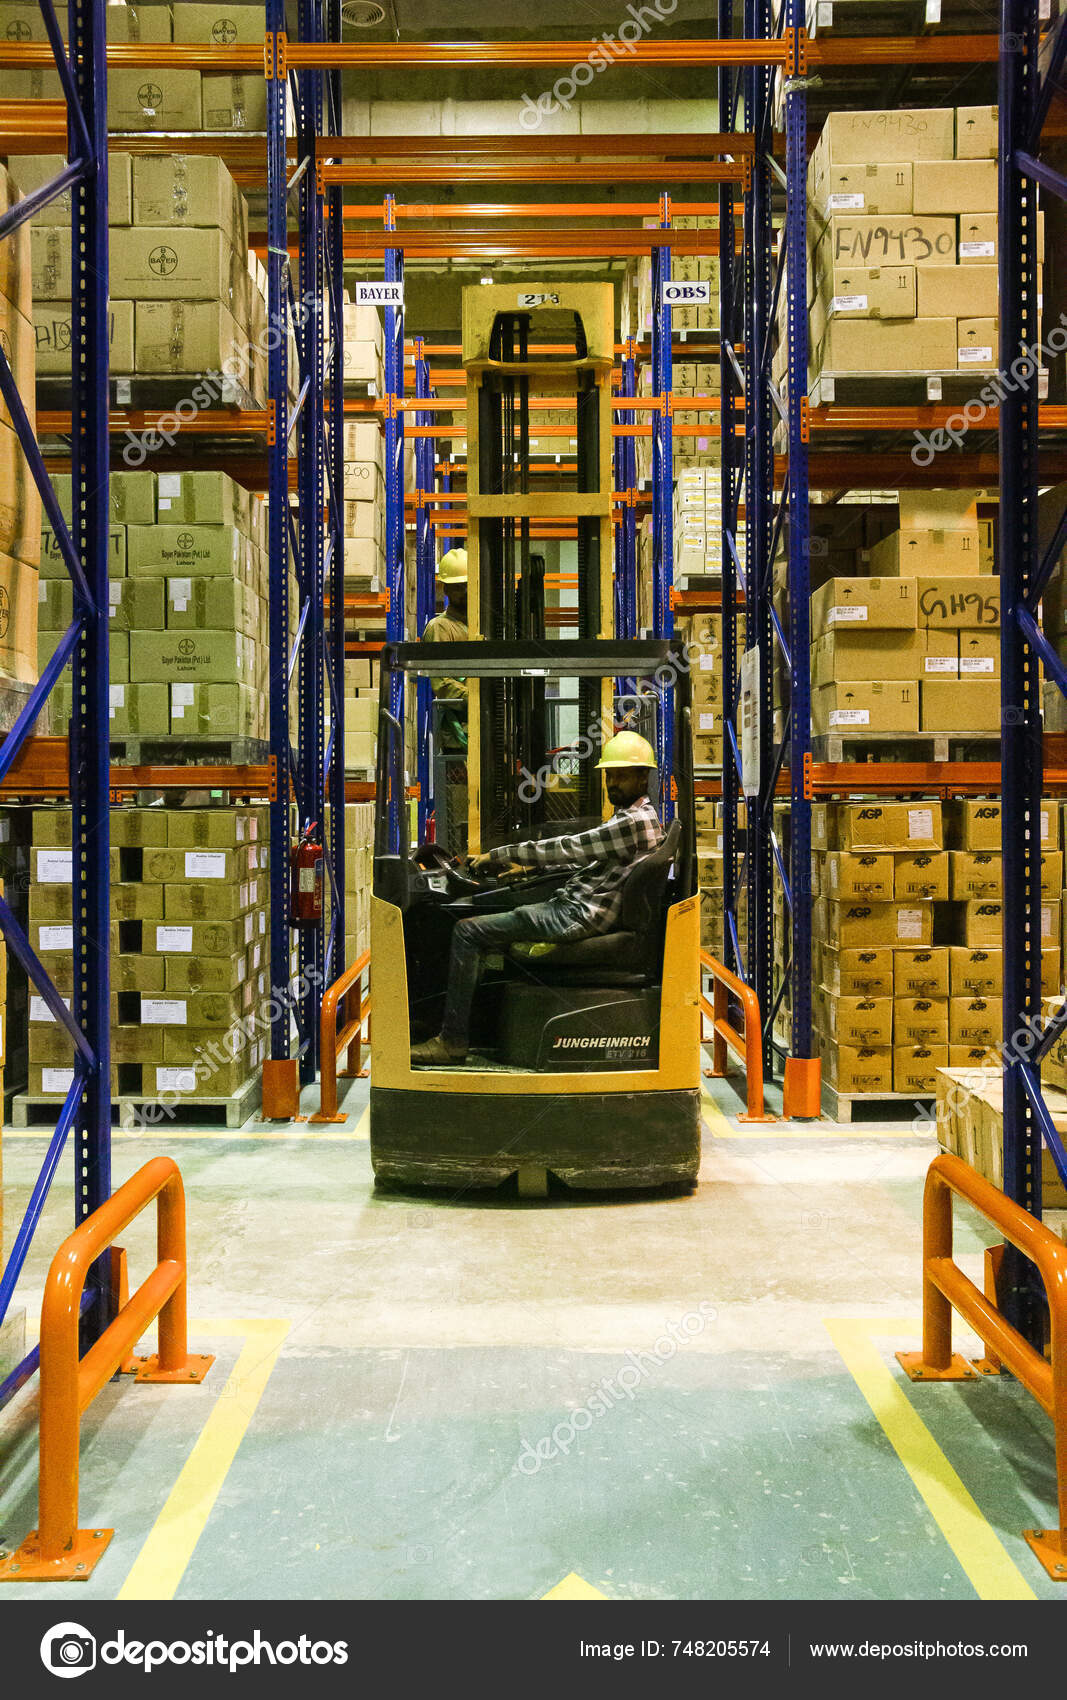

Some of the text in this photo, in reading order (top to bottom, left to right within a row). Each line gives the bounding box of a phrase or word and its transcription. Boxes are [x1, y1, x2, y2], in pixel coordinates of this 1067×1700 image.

[835, 227, 953, 260] FN9430
[360, 287, 400, 300] BAYER
[665, 285, 707, 299] OBS
[857, 808, 883, 820] AGP
[974, 807, 1000, 819] AGP
[858, 856, 878, 866] AGP
[912, 856, 932, 866] AGP
[846, 907, 872, 918] AGP
[975, 905, 1001, 916] AGP
[913, 954, 932, 962] AGP
[969, 953, 988, 962] AGP
[968, 1002, 988, 1011] AGP
[553, 1036, 651, 1049] JUNGHEINRICH
[912, 1050, 932, 1058] AGP
